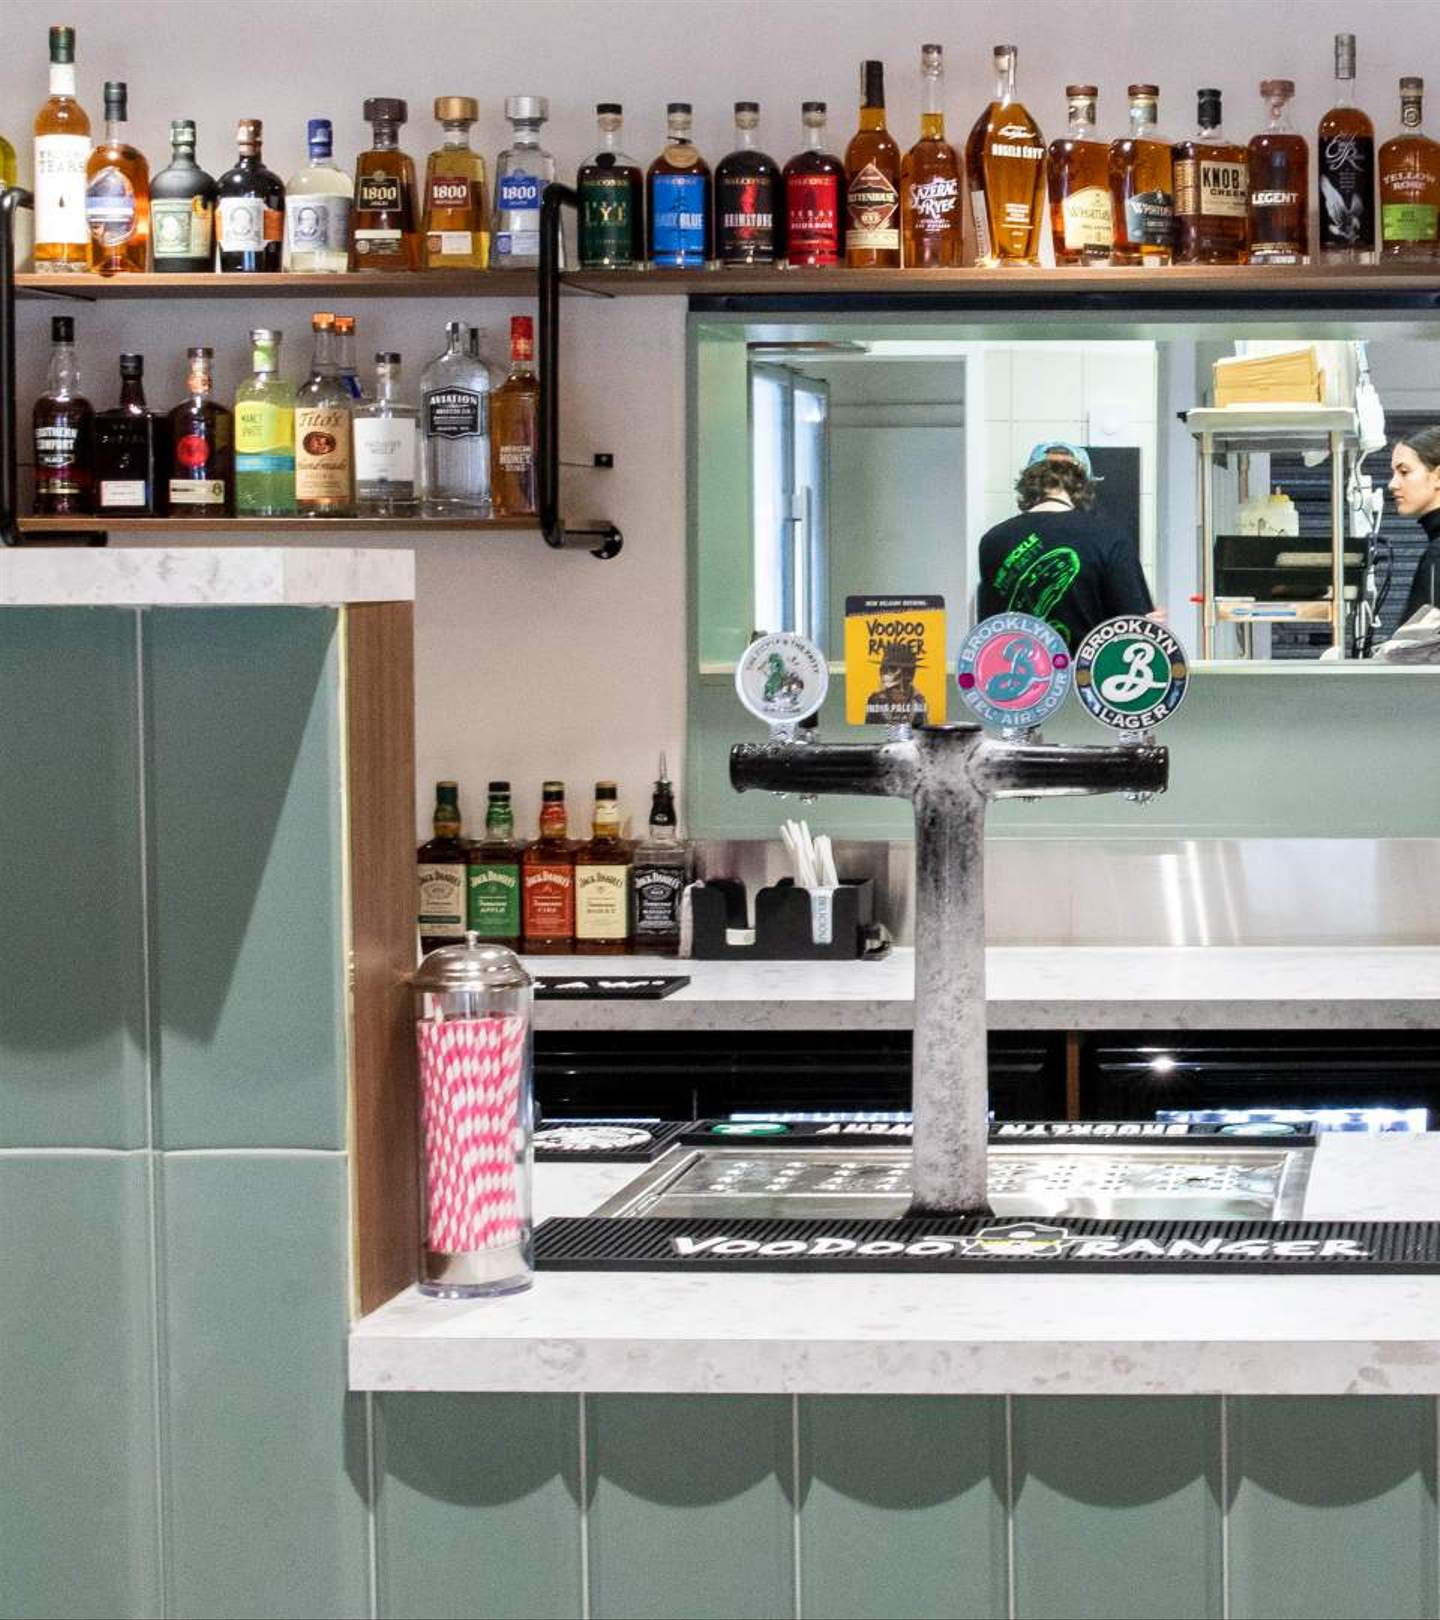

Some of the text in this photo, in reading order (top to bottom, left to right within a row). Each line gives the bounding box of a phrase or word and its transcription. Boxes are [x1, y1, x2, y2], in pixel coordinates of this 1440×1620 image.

[1203, 167, 1240, 189] KNOB
[1384, 171, 1436, 184] YELLOW
[363, 187, 397, 200] 1800
[433, 185, 467, 199] 1800
[503, 186, 537, 200] 1800
[910, 180, 959, 202] SAZERAC
[1210, 189, 1247, 197] CREEK
[1252, 192, 1299, 206] LEGENT
[430, 394, 477, 404] AVIATION
[300, 412, 343, 427] Tito's
[866, 619, 925, 637] VOODOO
[868, 637, 927, 656] RANGER
[962, 618, 1056, 663] BROOKLYN
[1081, 618, 1179, 661] BROOKLYN
[967, 672, 1068, 725] BEL AIR SOUR
[1099, 703, 1170, 729] LAGER
[816, 1123, 1189, 1137] BROOKLYN WERY
[674, 1237, 1369, 1257] VOODOO RANGER
